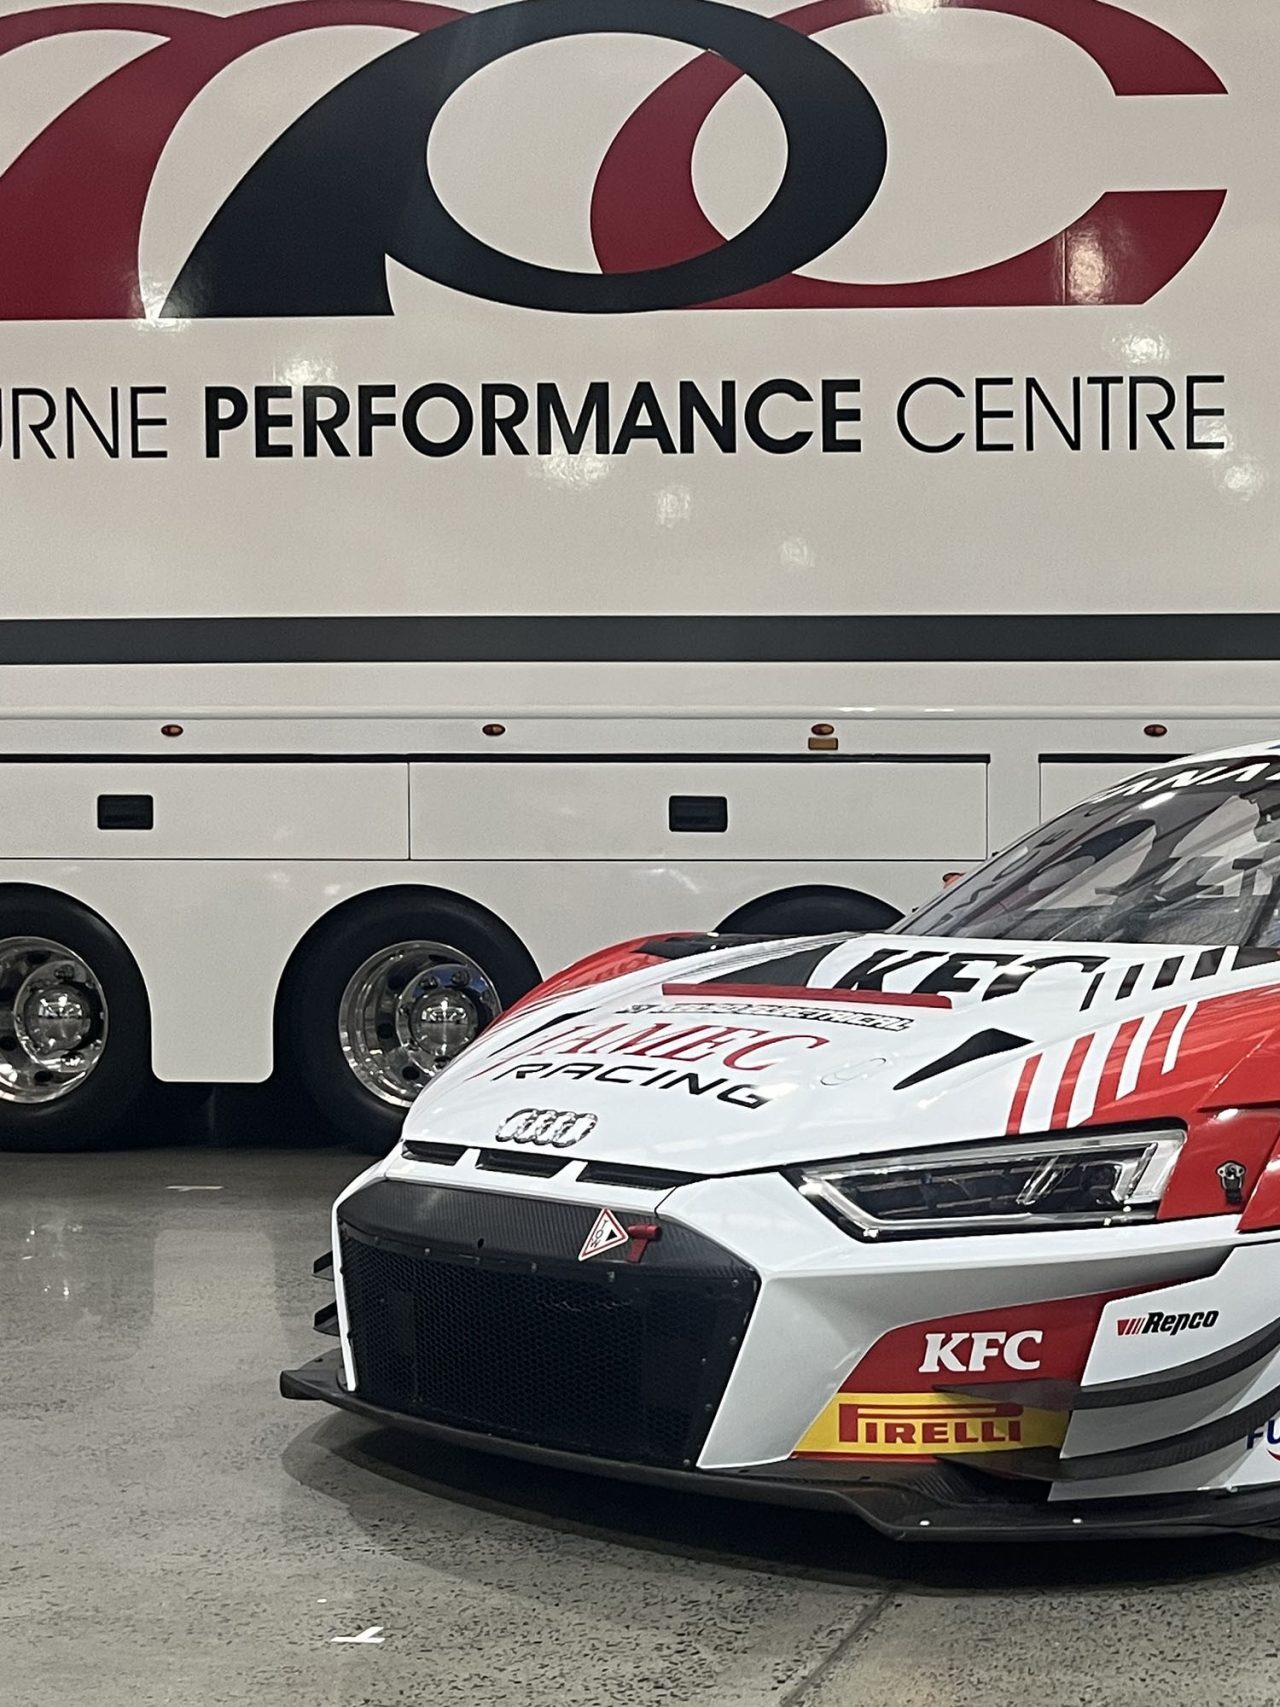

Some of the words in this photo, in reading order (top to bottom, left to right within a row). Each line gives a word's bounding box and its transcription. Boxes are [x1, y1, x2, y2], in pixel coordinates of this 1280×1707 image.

[0, 386, 168, 459] RNE
[204, 378, 863, 459] PERFORMANCE
[896, 375, 1227, 453] CENTRE
[492, 1062, 775, 1109] RACING
[1141, 1310, 1220, 1336] Repco
[918, 1330, 1043, 1373] KFC
[838, 1402, 1024, 1444] PIRELLI
